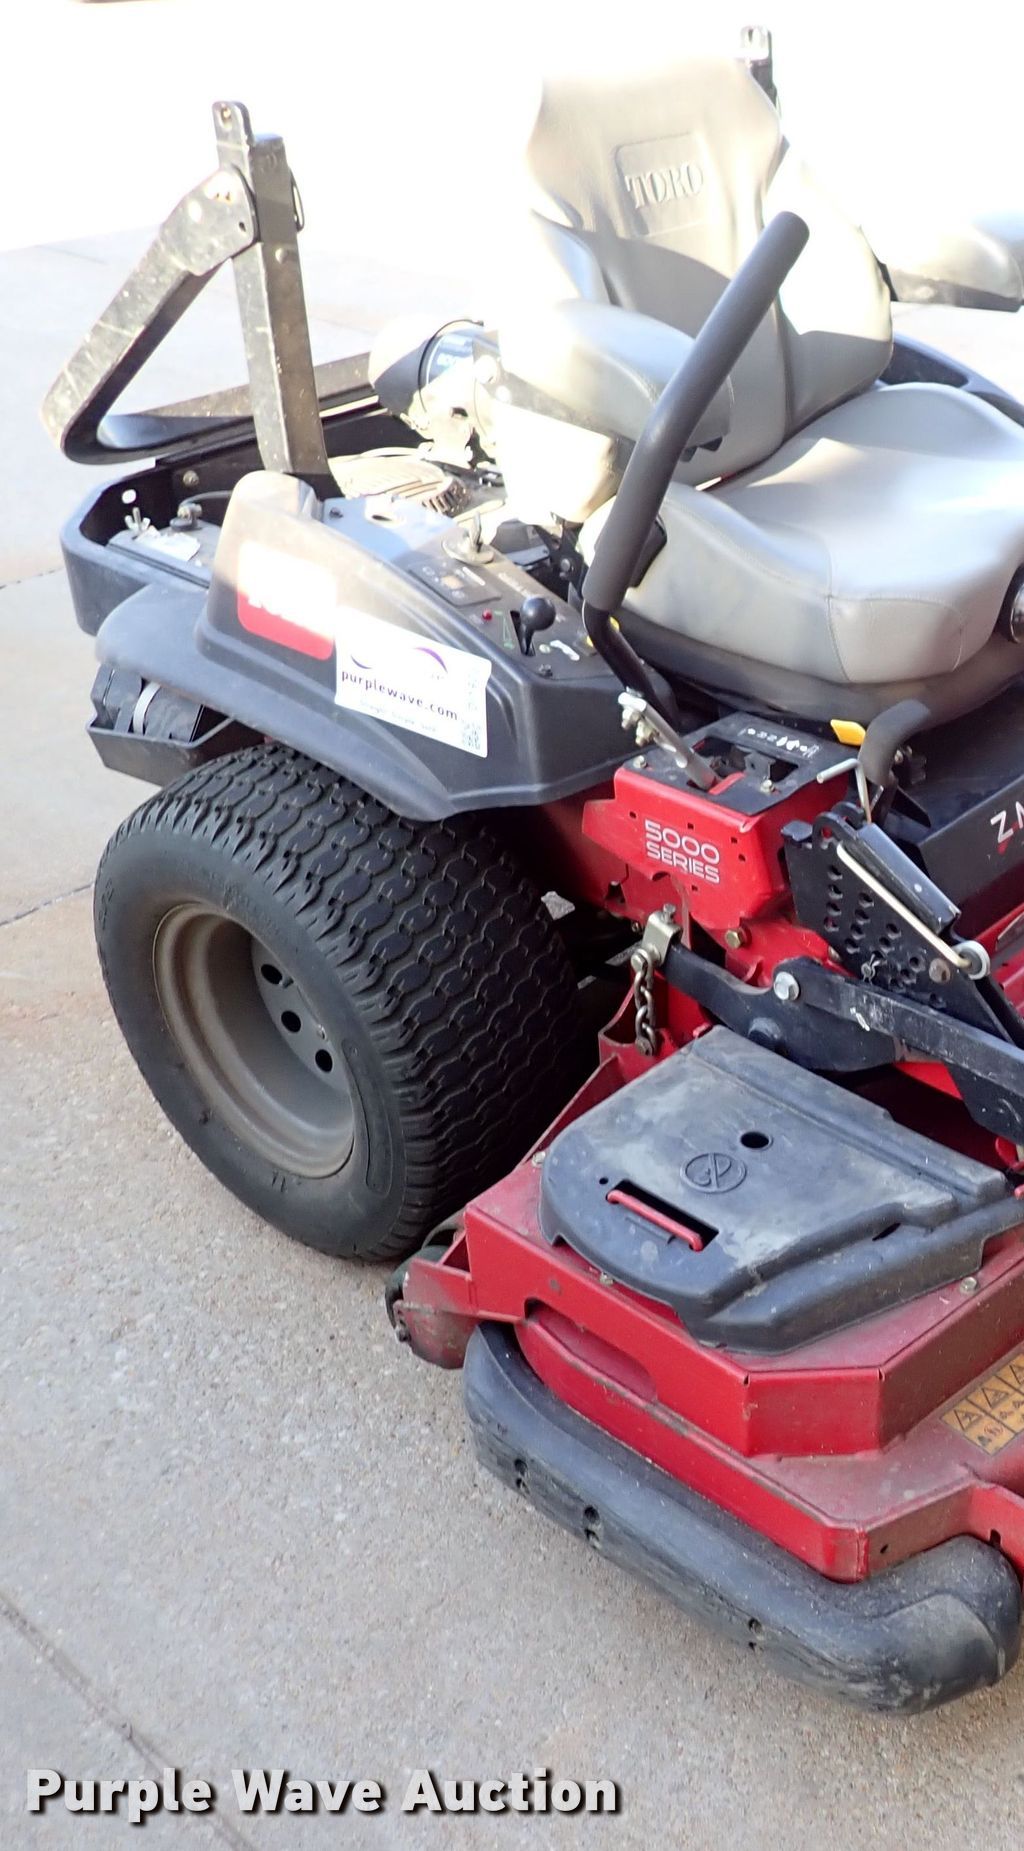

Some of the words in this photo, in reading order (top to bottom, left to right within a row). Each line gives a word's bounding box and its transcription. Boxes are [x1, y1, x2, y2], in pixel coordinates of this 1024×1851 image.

[623, 163, 704, 210] TORO
[341, 670, 458, 721] purplewave.com
[644, 818, 720, 865] 5000
[990, 810, 1014, 844] Z
[645, 840, 720, 884] SERIES
